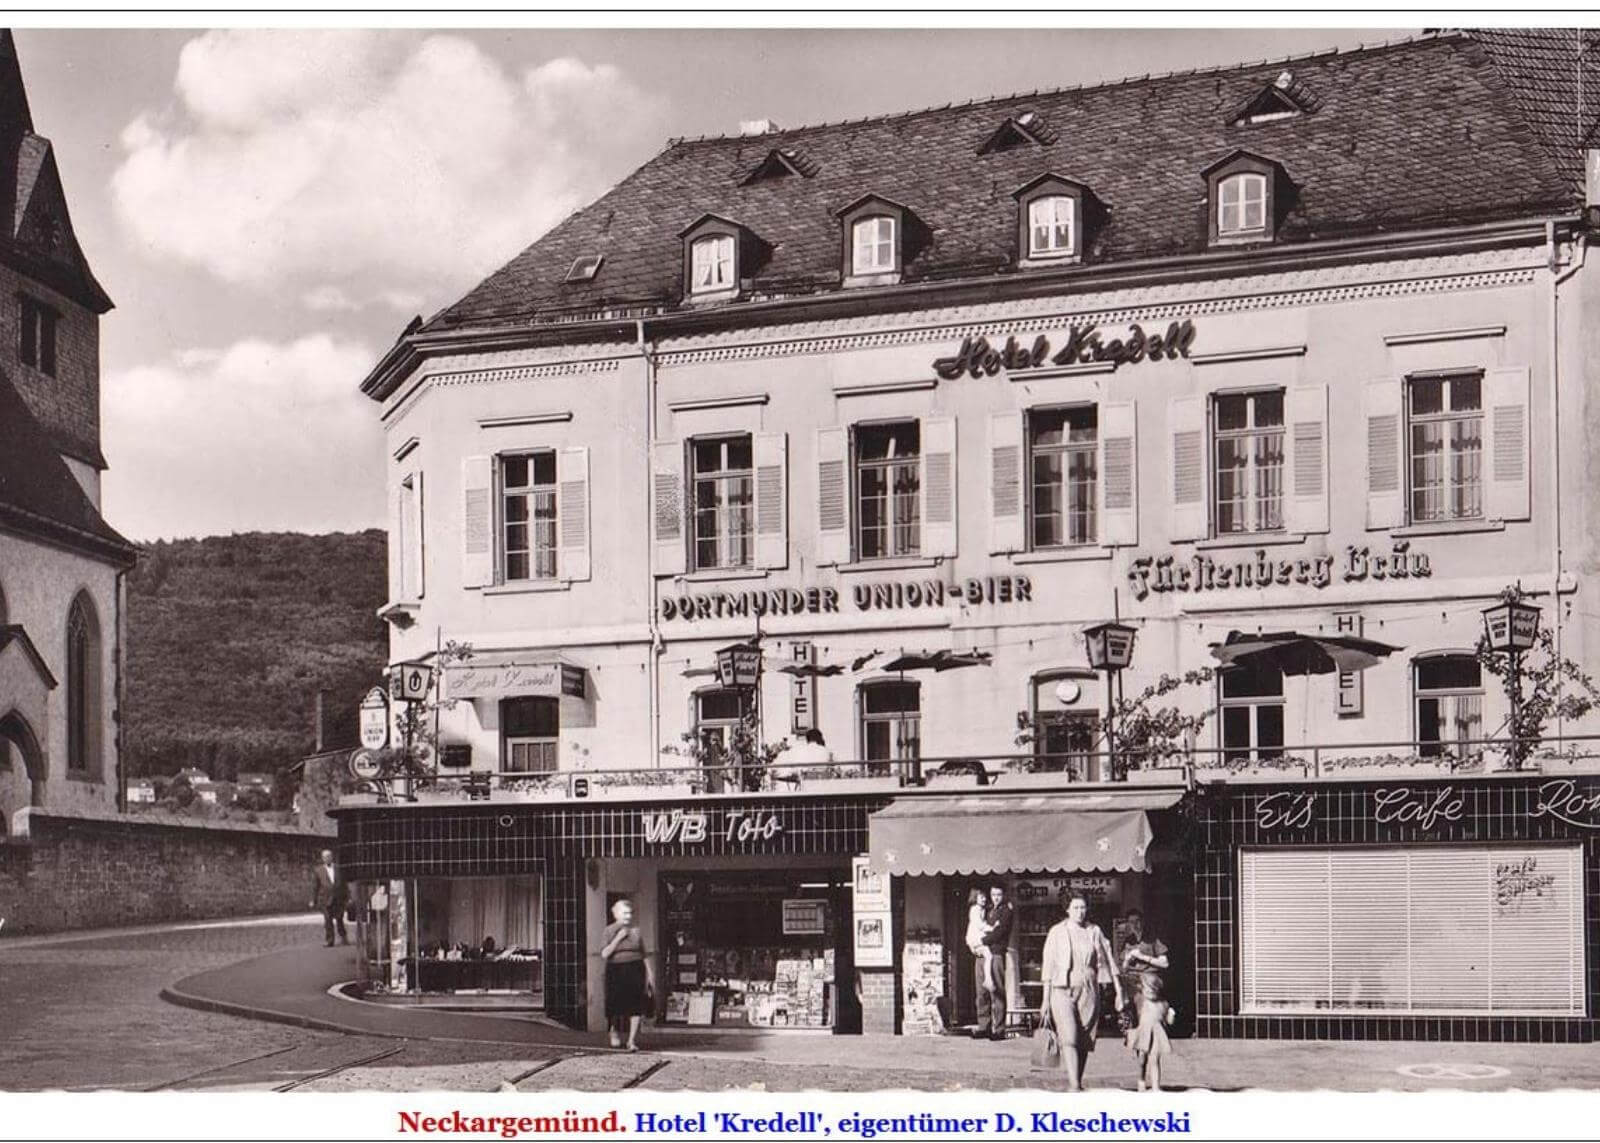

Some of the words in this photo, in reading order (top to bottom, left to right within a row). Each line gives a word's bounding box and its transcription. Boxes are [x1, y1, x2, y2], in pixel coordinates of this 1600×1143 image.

[933, 335, 1049, 380] Hotel
[1052, 319, 1195, 366] Kredell
[1343, 541, 1432, 582] Bräu
[662, 588, 839, 620] DORTMUNDER
[853, 577, 1033, 612] UNION-BIER
[1337, 615, 1354, 708] HEL
[793, 645, 808, 731] HTEL
[642, 810, 707, 843] WB
[1255, 791, 1313, 829] Eis
[1375, 786, 1462, 831] Cafe
